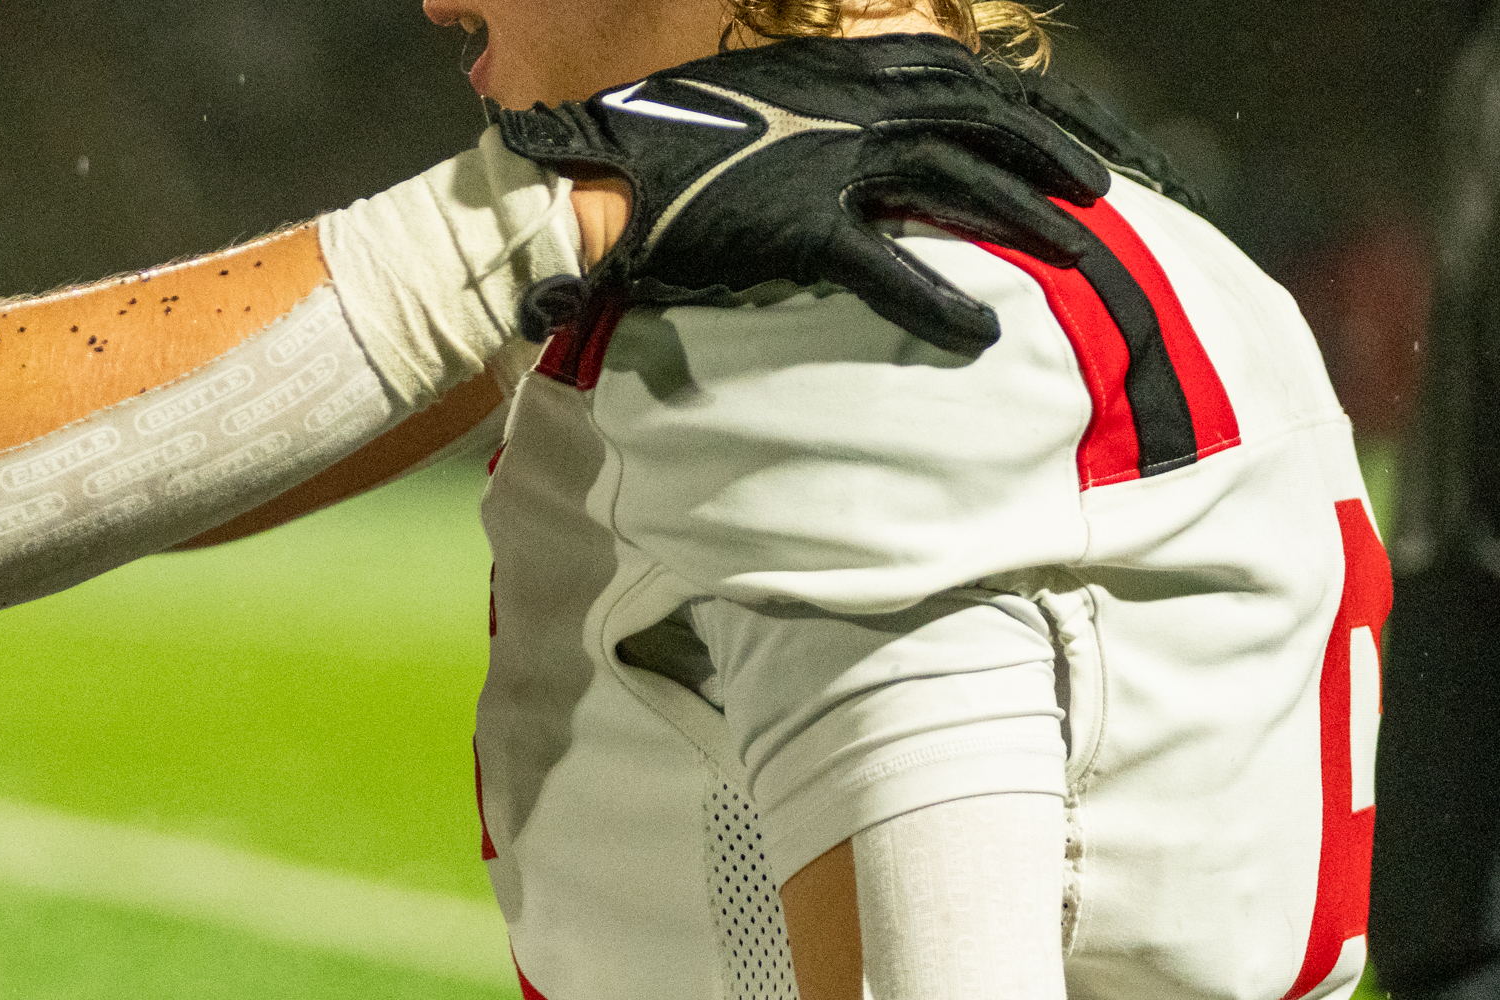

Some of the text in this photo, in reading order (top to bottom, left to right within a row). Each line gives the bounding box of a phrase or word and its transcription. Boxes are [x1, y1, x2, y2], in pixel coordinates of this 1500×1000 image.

[147, 370, 246, 429] BATTLE
[233, 359, 332, 430] BATTLE
[10, 430, 112, 487] BATTLE
[94, 436, 199, 490] BATTLE
